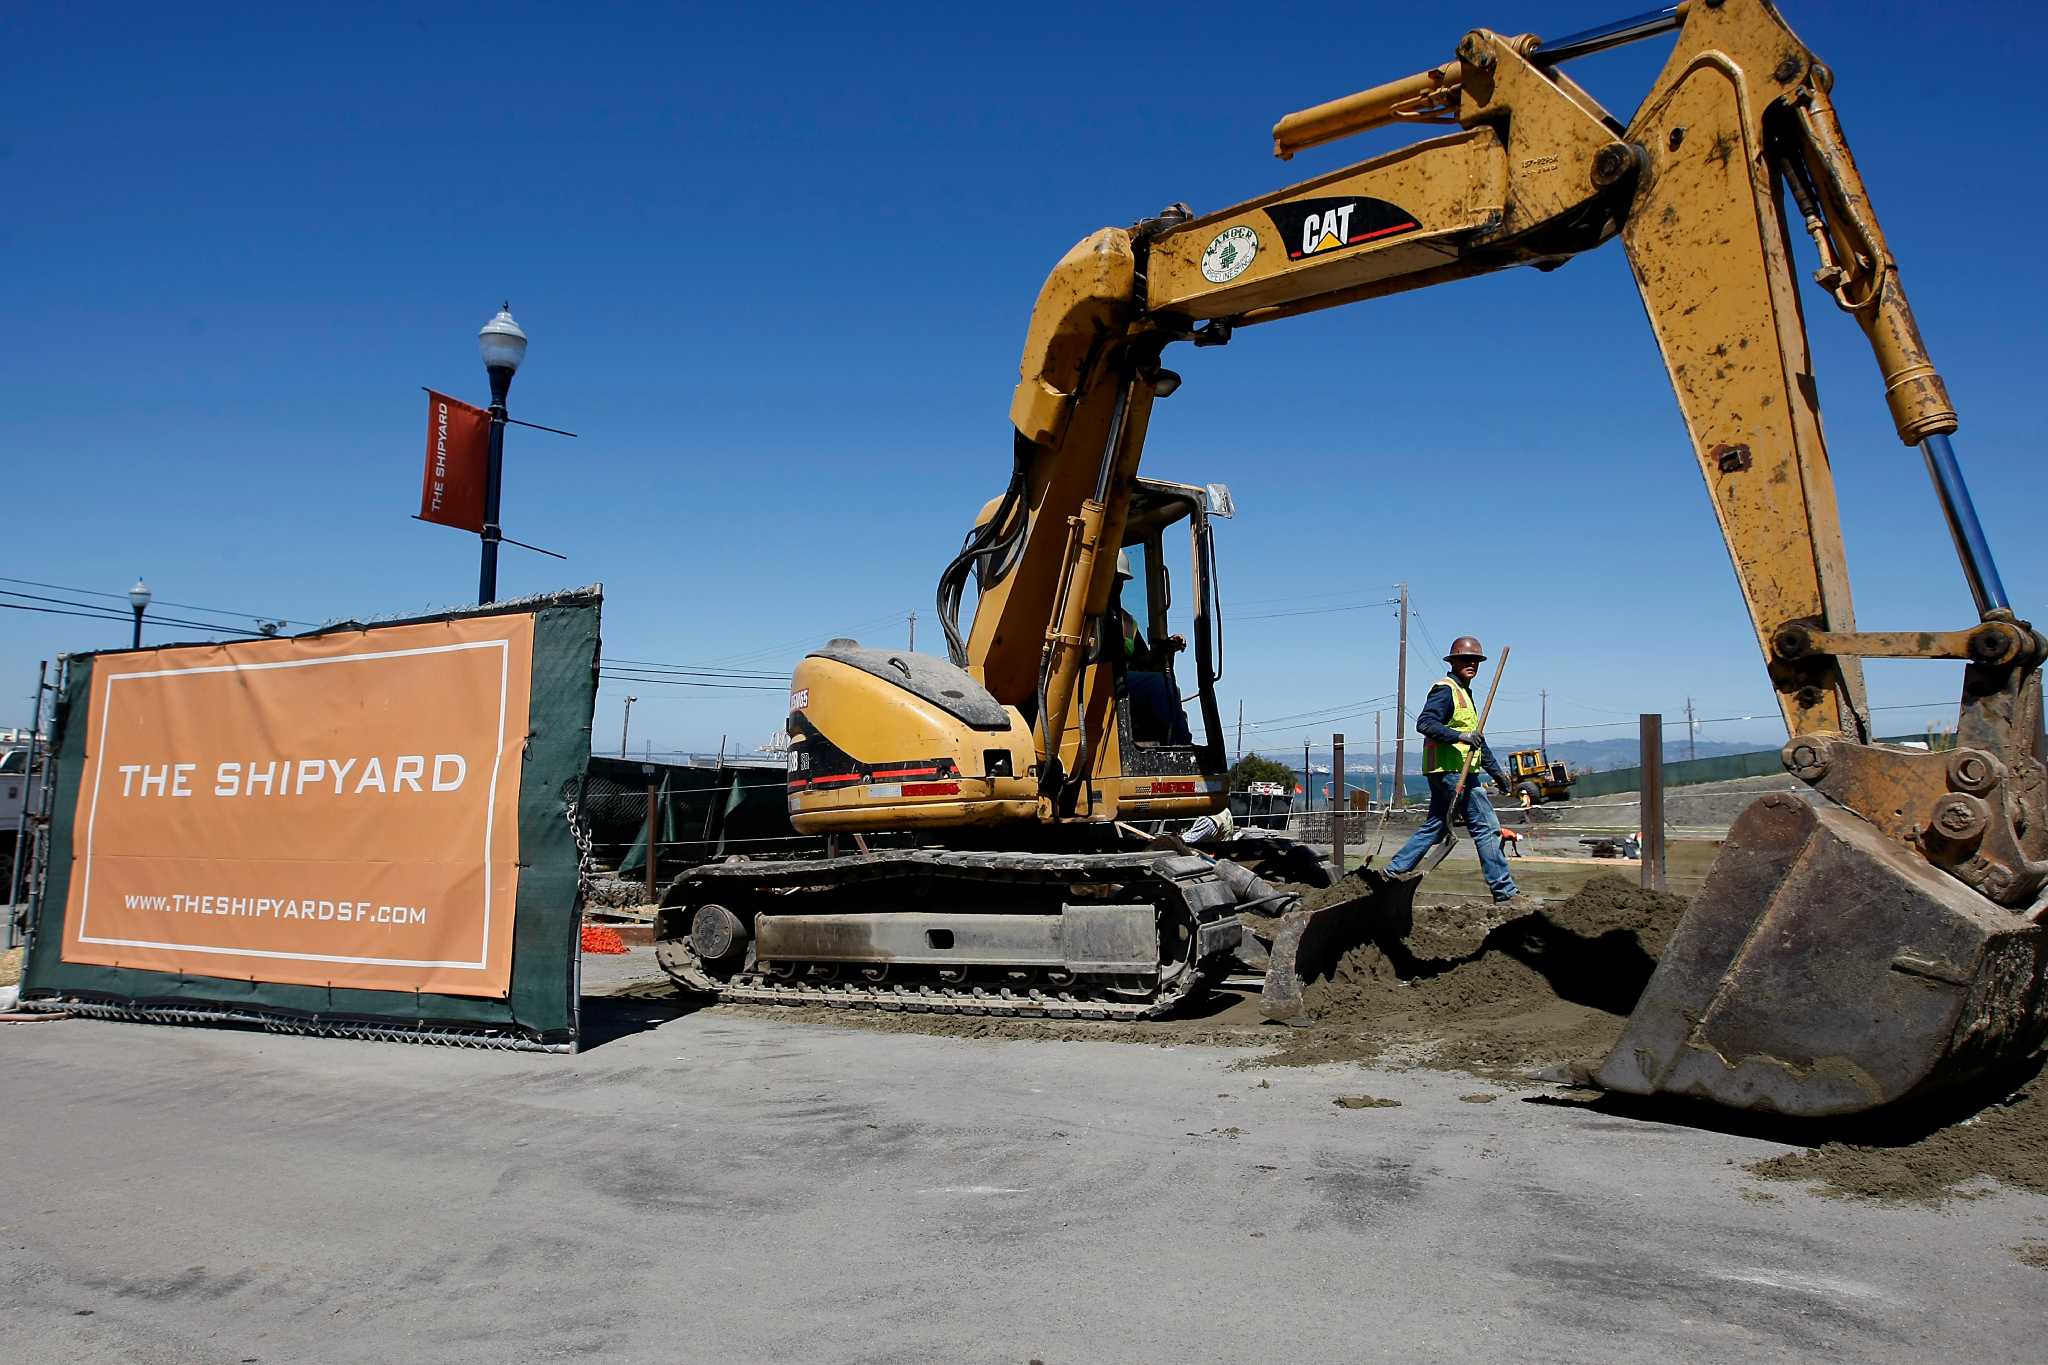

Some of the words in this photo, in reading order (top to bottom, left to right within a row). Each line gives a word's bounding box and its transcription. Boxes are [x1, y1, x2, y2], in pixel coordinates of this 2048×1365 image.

[1302, 203, 1355, 254] CAT
[435, 402, 448, 478] SHIPYARD
[431, 481, 444, 513] THE
[118, 763, 196, 798] THE
[213, 753, 467, 797] SHIPYARD
